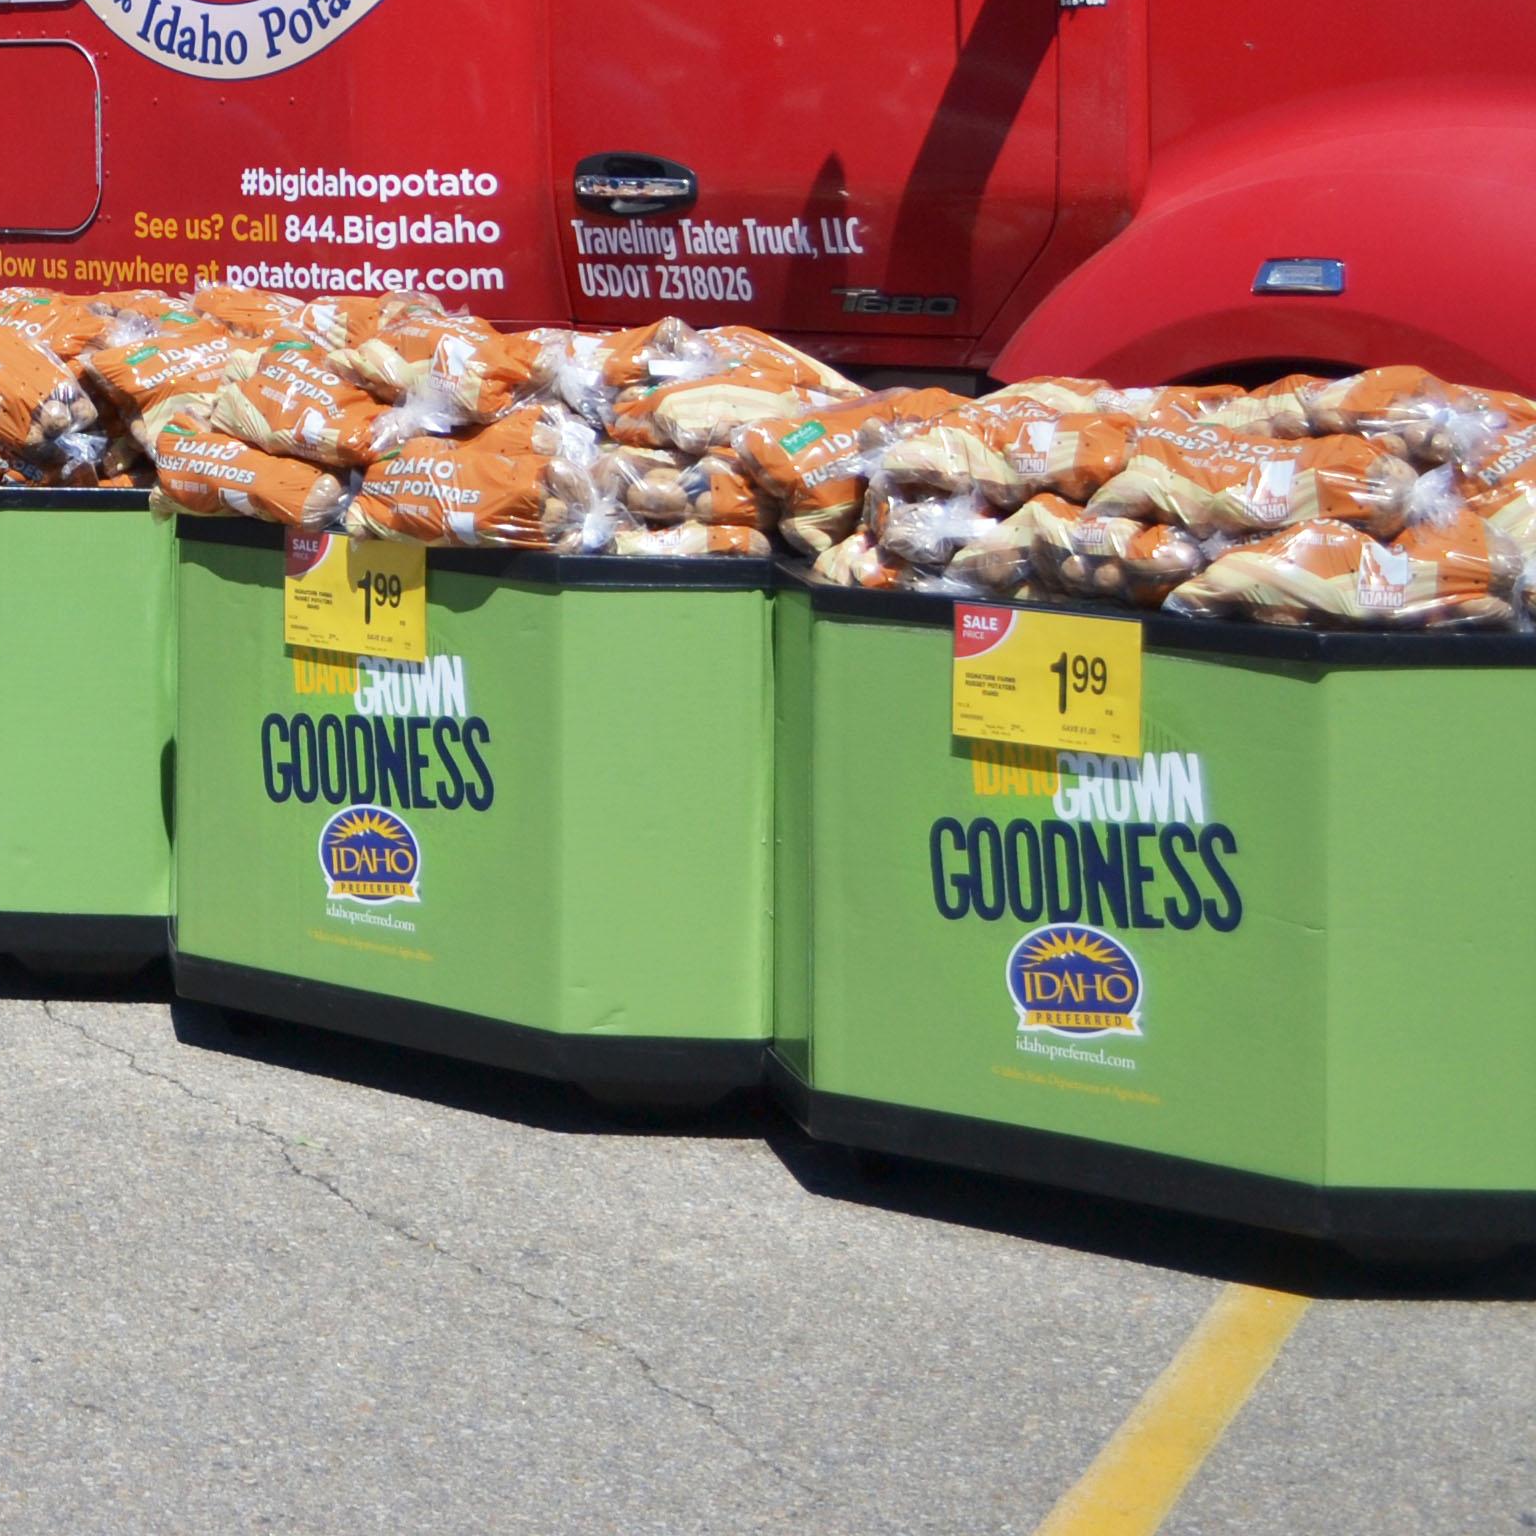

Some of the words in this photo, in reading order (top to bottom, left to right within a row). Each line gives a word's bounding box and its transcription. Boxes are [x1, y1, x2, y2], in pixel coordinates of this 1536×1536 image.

[240, 167, 499, 203] #bigidahopotato
[133, 212, 180, 240] See
[185, 212, 225, 241] us?
[230, 213, 278, 242] Call
[284, 213, 501, 250] 844.BigIdaho
[571, 218, 678, 261] Traveling
[678, 218, 741, 255] Tater
[742, 218, 818, 260] Truck,
[820, 216, 864, 255] LLC
[42, 255, 68, 279] us
[74, 254, 189, 288] anywhere
[194, 257, 219, 284] at
[225, 261, 504, 293] potatotracker.com
[577, 262, 651, 299] USDOT
[654, 264, 753, 302] 2318026
[831, 287, 959, 316] T680
[277, 349, 341, 387] IDAHO
[174, 437, 249, 461] IDAHO
[186, 456, 257, 485] POTATOES
[384, 456, 455, 479] IDAHO
[402, 479, 481, 505] POTATOES
[292, 537, 319, 552] SALE
[962, 614, 998, 631] SALE
[962, 629, 985, 640] PRICE
[352, 654, 466, 717] GROWN
[260, 712, 495, 812] GOODNESS
[1052, 750, 1206, 824] GROWN
[331, 845, 415, 876] IDAHO
[929, 816, 1244, 933] GOODNESS
[340, 882, 406, 895] PREFERRED
[325, 902, 417, 932] idahopreferred.com
[1023, 969, 1134, 1004] IDAHO
[1035, 1012, 1124, 1026] PREFERRED
[1015, 1035, 1137, 1070] idahopreferred.com
